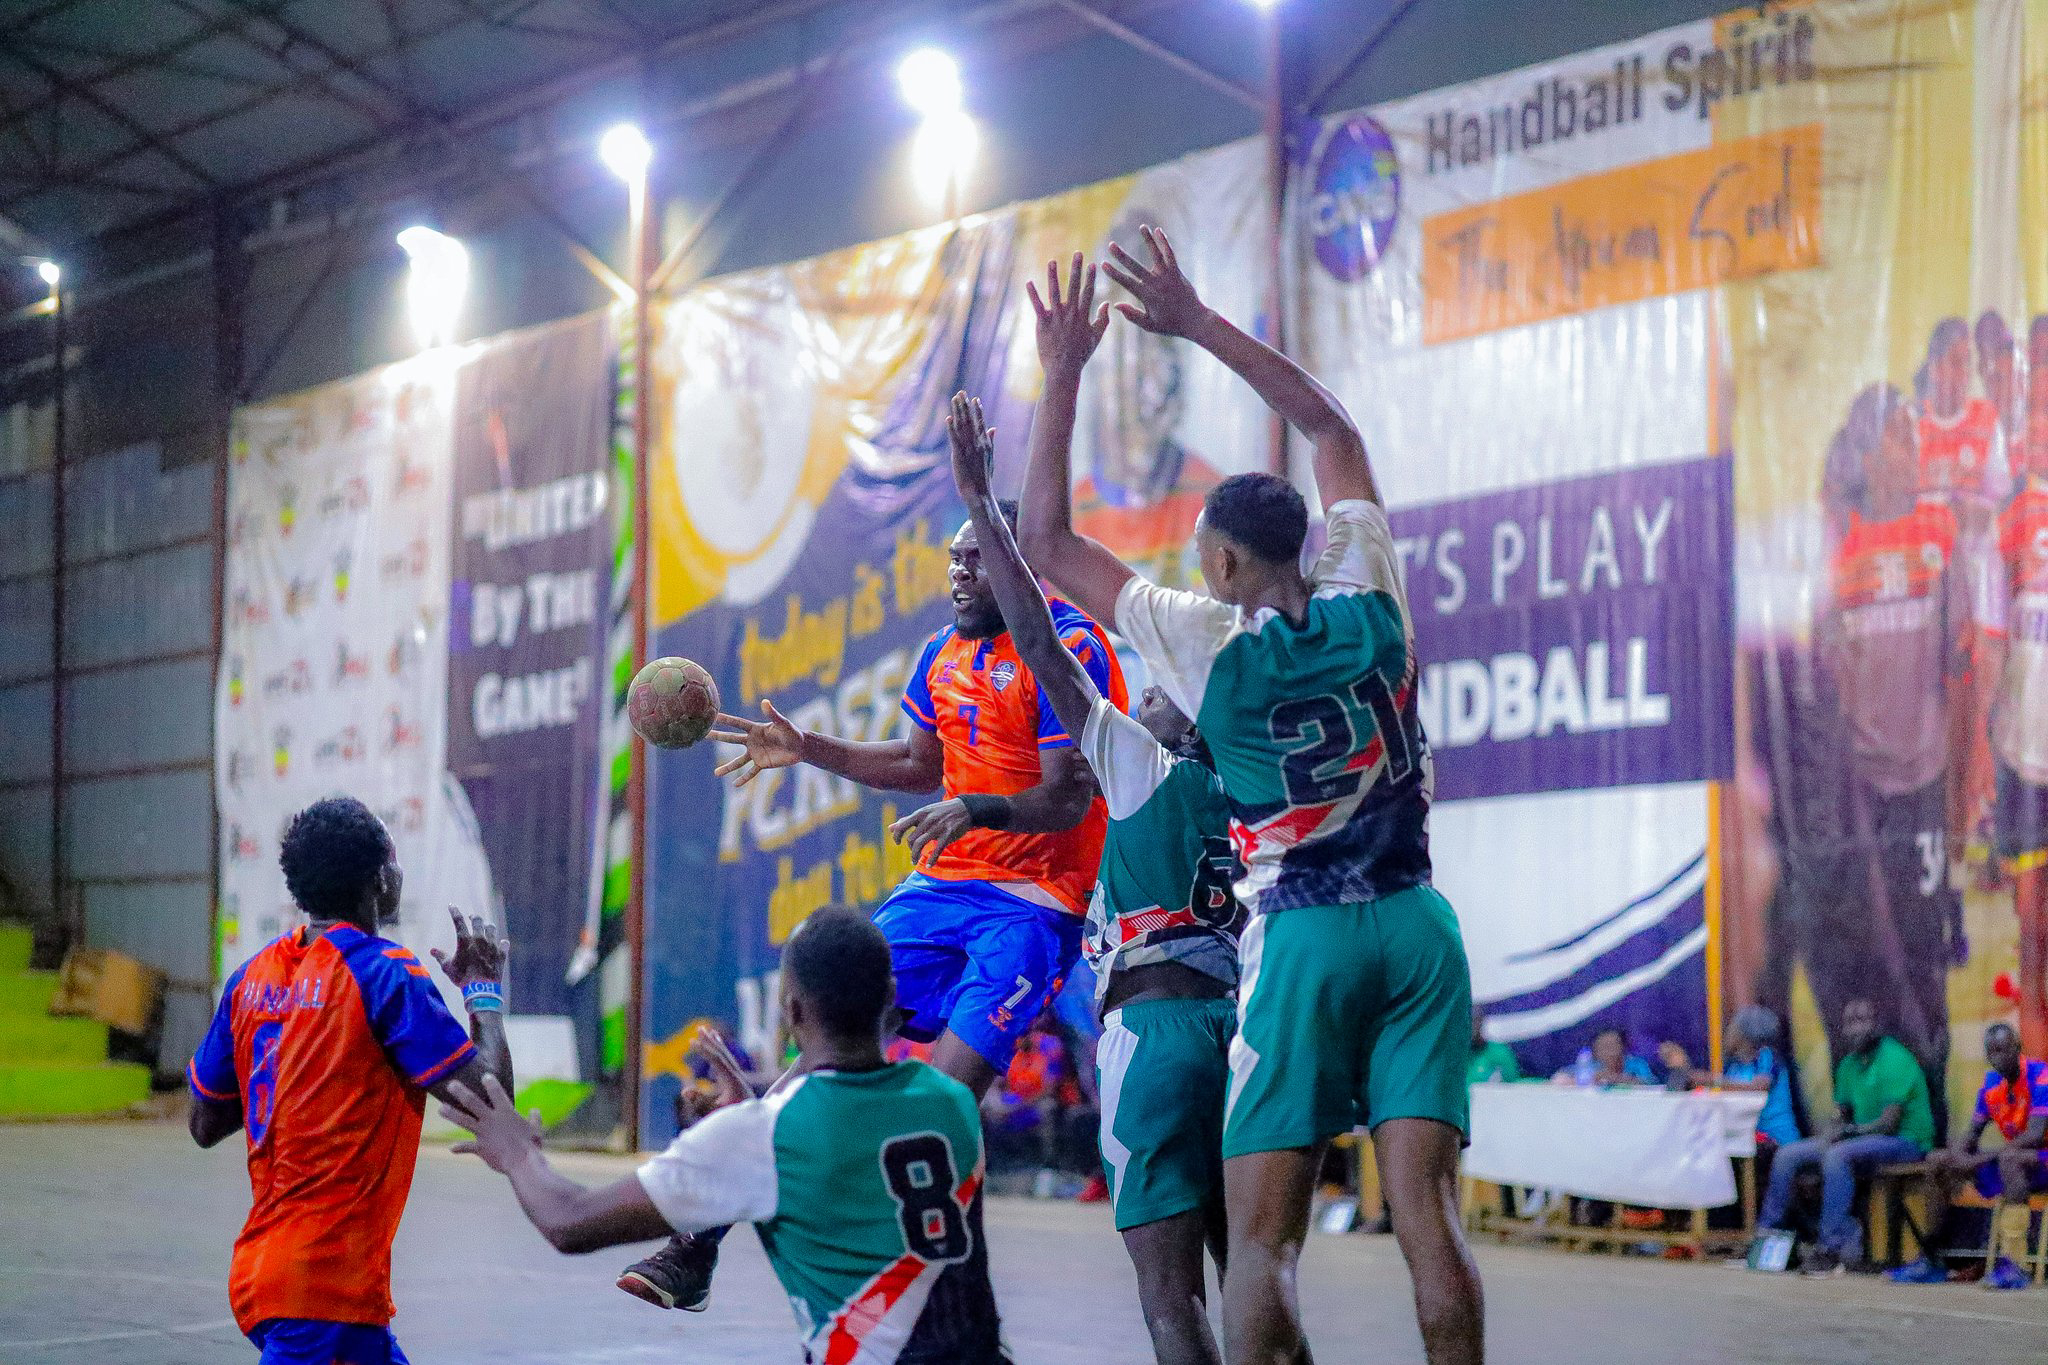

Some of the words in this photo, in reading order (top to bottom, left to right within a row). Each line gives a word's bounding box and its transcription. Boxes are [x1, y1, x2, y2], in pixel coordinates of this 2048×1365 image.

[1424, 55, 1646, 174] Handball
[1663, 13, 1816, 119] Spirit
[1395, 528, 1468, 614] T'S
[1493, 497, 1674, 606] PLAY
[958, 704, 979, 747] 7
[1267, 667, 1413, 808] 21
[1418, 636, 1673, 750] NDBALL
[1003, 974, 1033, 1010] 7
[879, 1130, 973, 1265] 8
